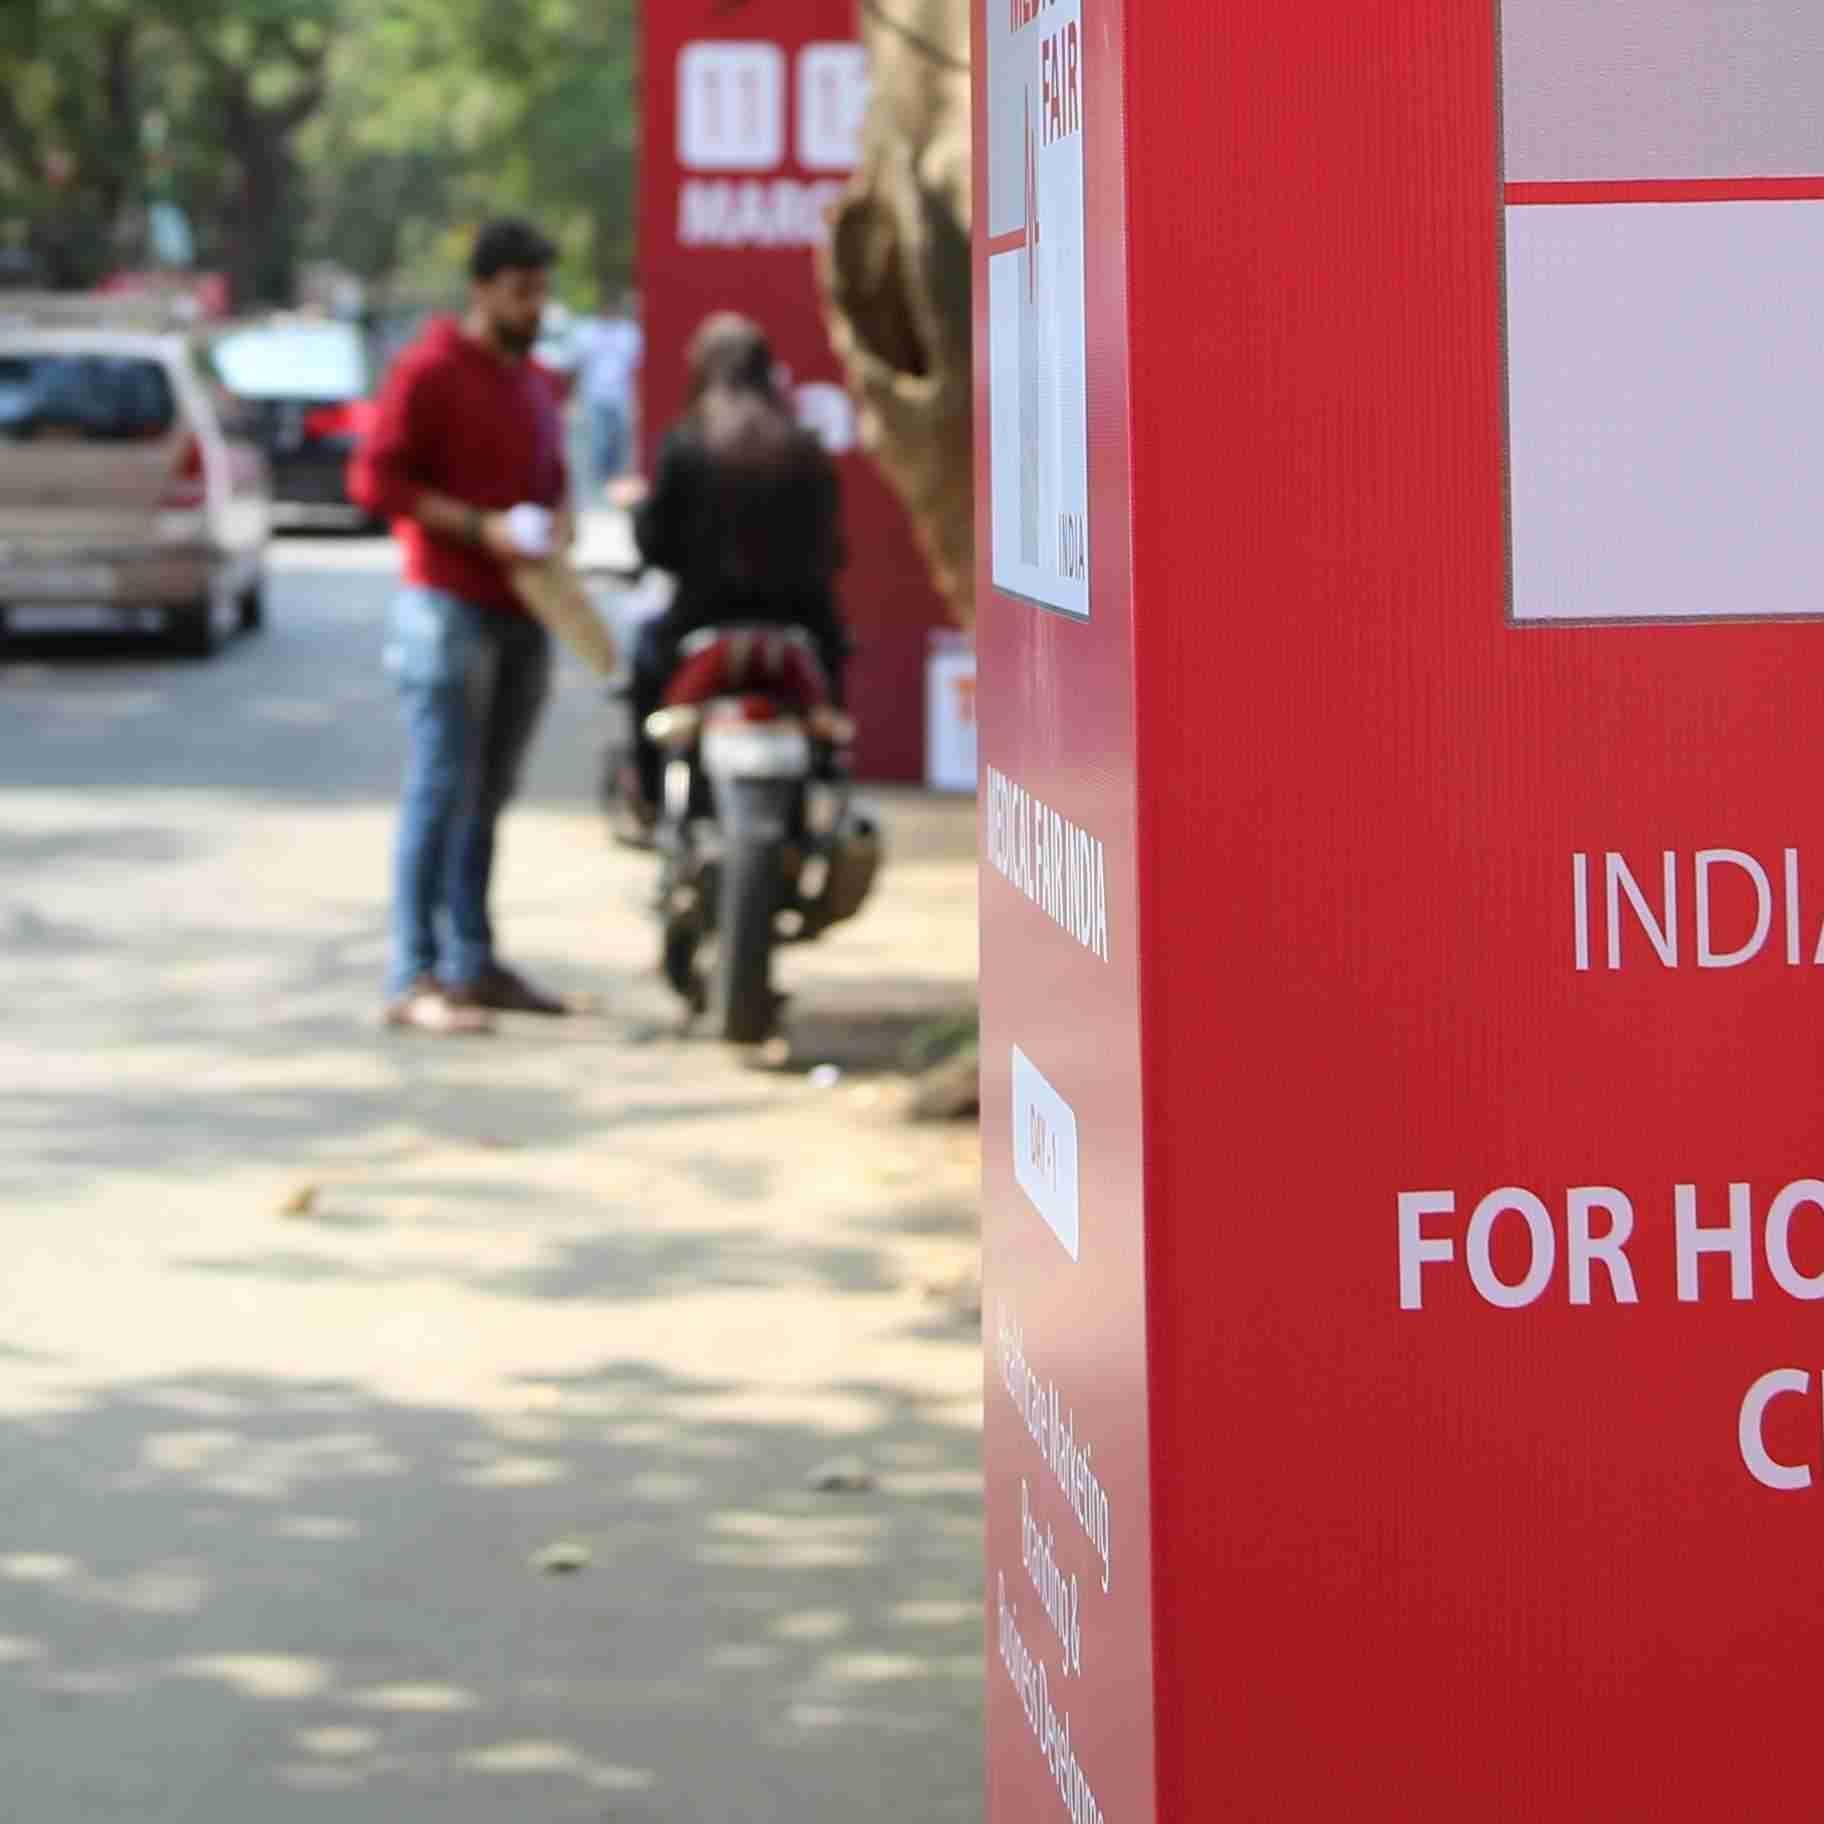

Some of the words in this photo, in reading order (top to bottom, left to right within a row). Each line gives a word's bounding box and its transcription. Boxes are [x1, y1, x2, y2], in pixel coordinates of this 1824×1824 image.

[1042, 20, 1079, 147] FAIR
[1058, 510, 1086, 581] INDIA
[987, 763, 1034, 901] MEDICAL
[1035, 799, 1064, 927] FAIR
[1065, 819, 1108, 964] INDIA
[1395, 1183, 1638, 1311] FOR
[1049, 1378, 1110, 1594] Marketing
[998, 1570, 1038, 1735] Business
[1021, 1478, 1069, 1676] Branding
